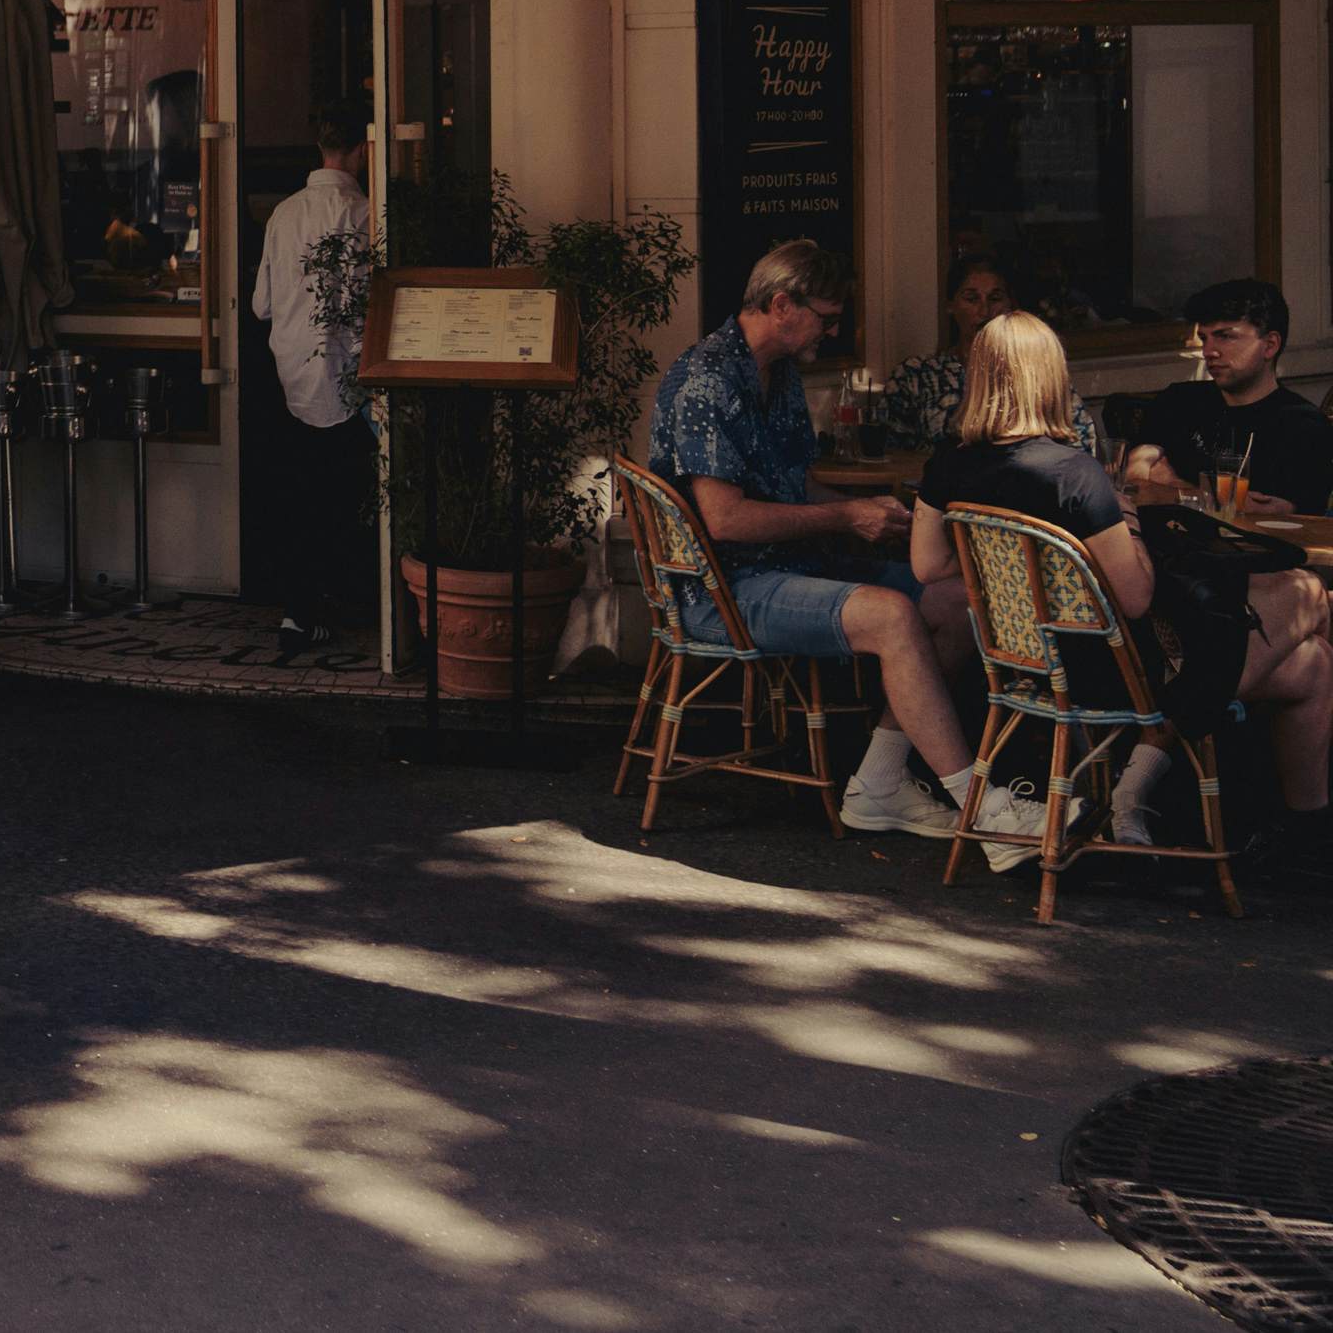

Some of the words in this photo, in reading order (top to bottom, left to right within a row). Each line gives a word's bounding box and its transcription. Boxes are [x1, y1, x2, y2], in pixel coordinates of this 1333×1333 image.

[752, 24, 832, 73] Happy
[760, 67, 822, 96] Hour
[742, 173, 803, 189] PRODUITS
[806, 171, 839, 186] FRAIS
[791, 196, 840, 212] MAISON
